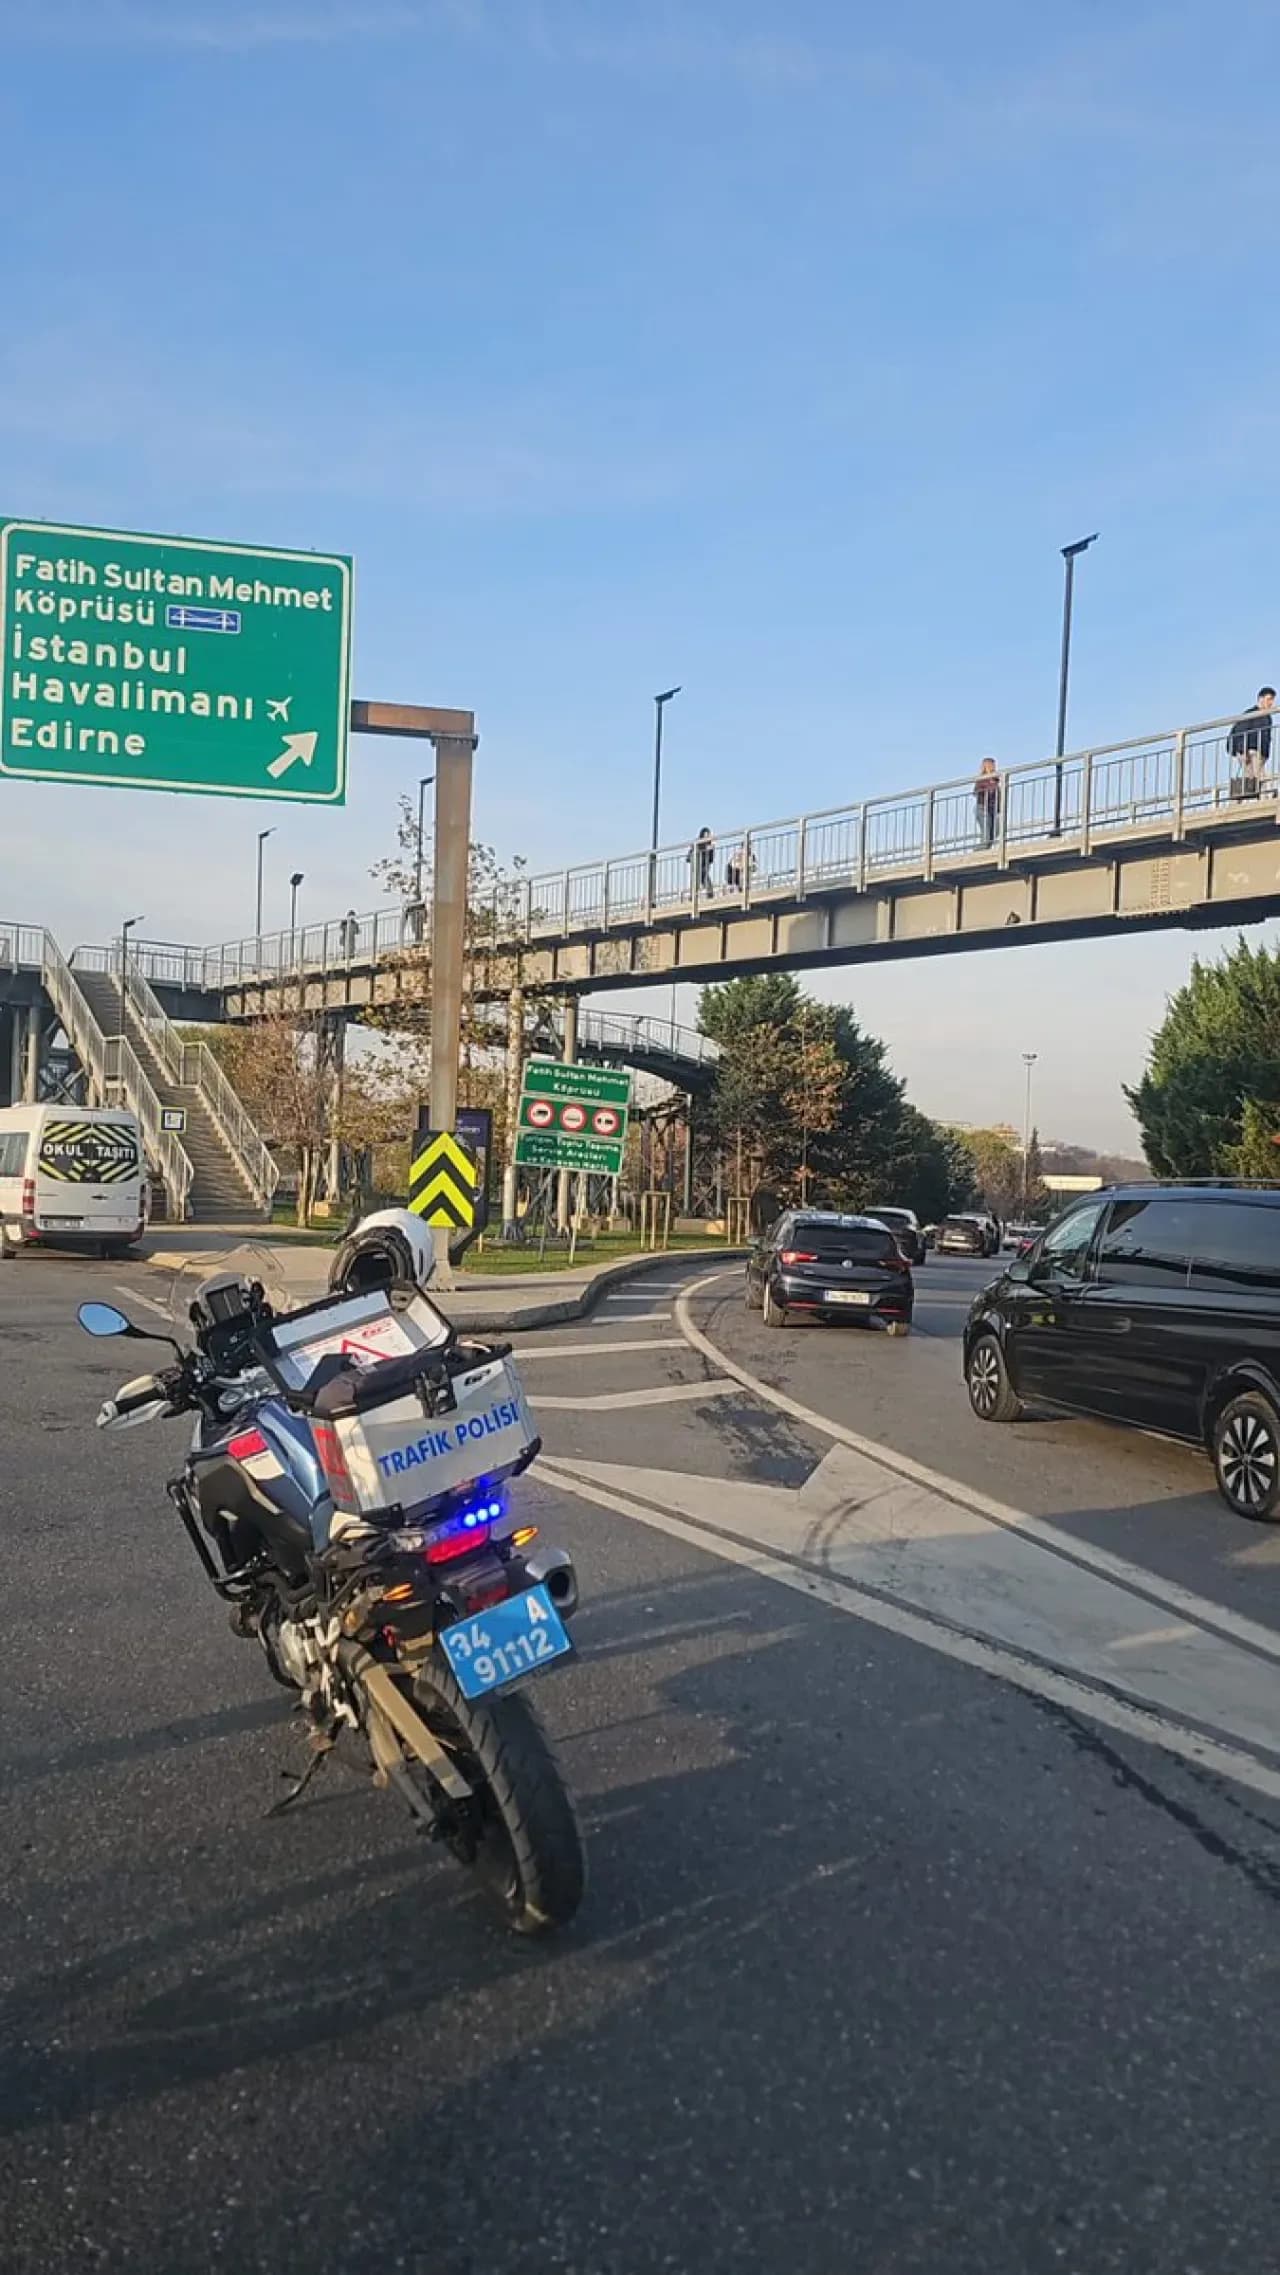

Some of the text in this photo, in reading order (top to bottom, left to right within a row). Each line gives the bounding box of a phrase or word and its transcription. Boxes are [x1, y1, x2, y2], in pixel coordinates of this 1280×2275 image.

[14, 589, 155, 625] Köprüsü
[15, 554, 333, 612] Fatih Sultan Mehmet
[12, 623, 187, 675] İstanbul
[12, 671, 253, 720] Havalimanı
[10, 718, 146, 757] Edirne
[527, 1065, 629, 1086] Fatih Sultan Mehmet
[43, 1143, 135, 1160] OKUL TAŞITI
[378, 1397, 519, 1477] TRAFİK POLİSİ
[449, 1595, 549, 1659] 34 A
[473, 1628, 555, 1683] 91112
